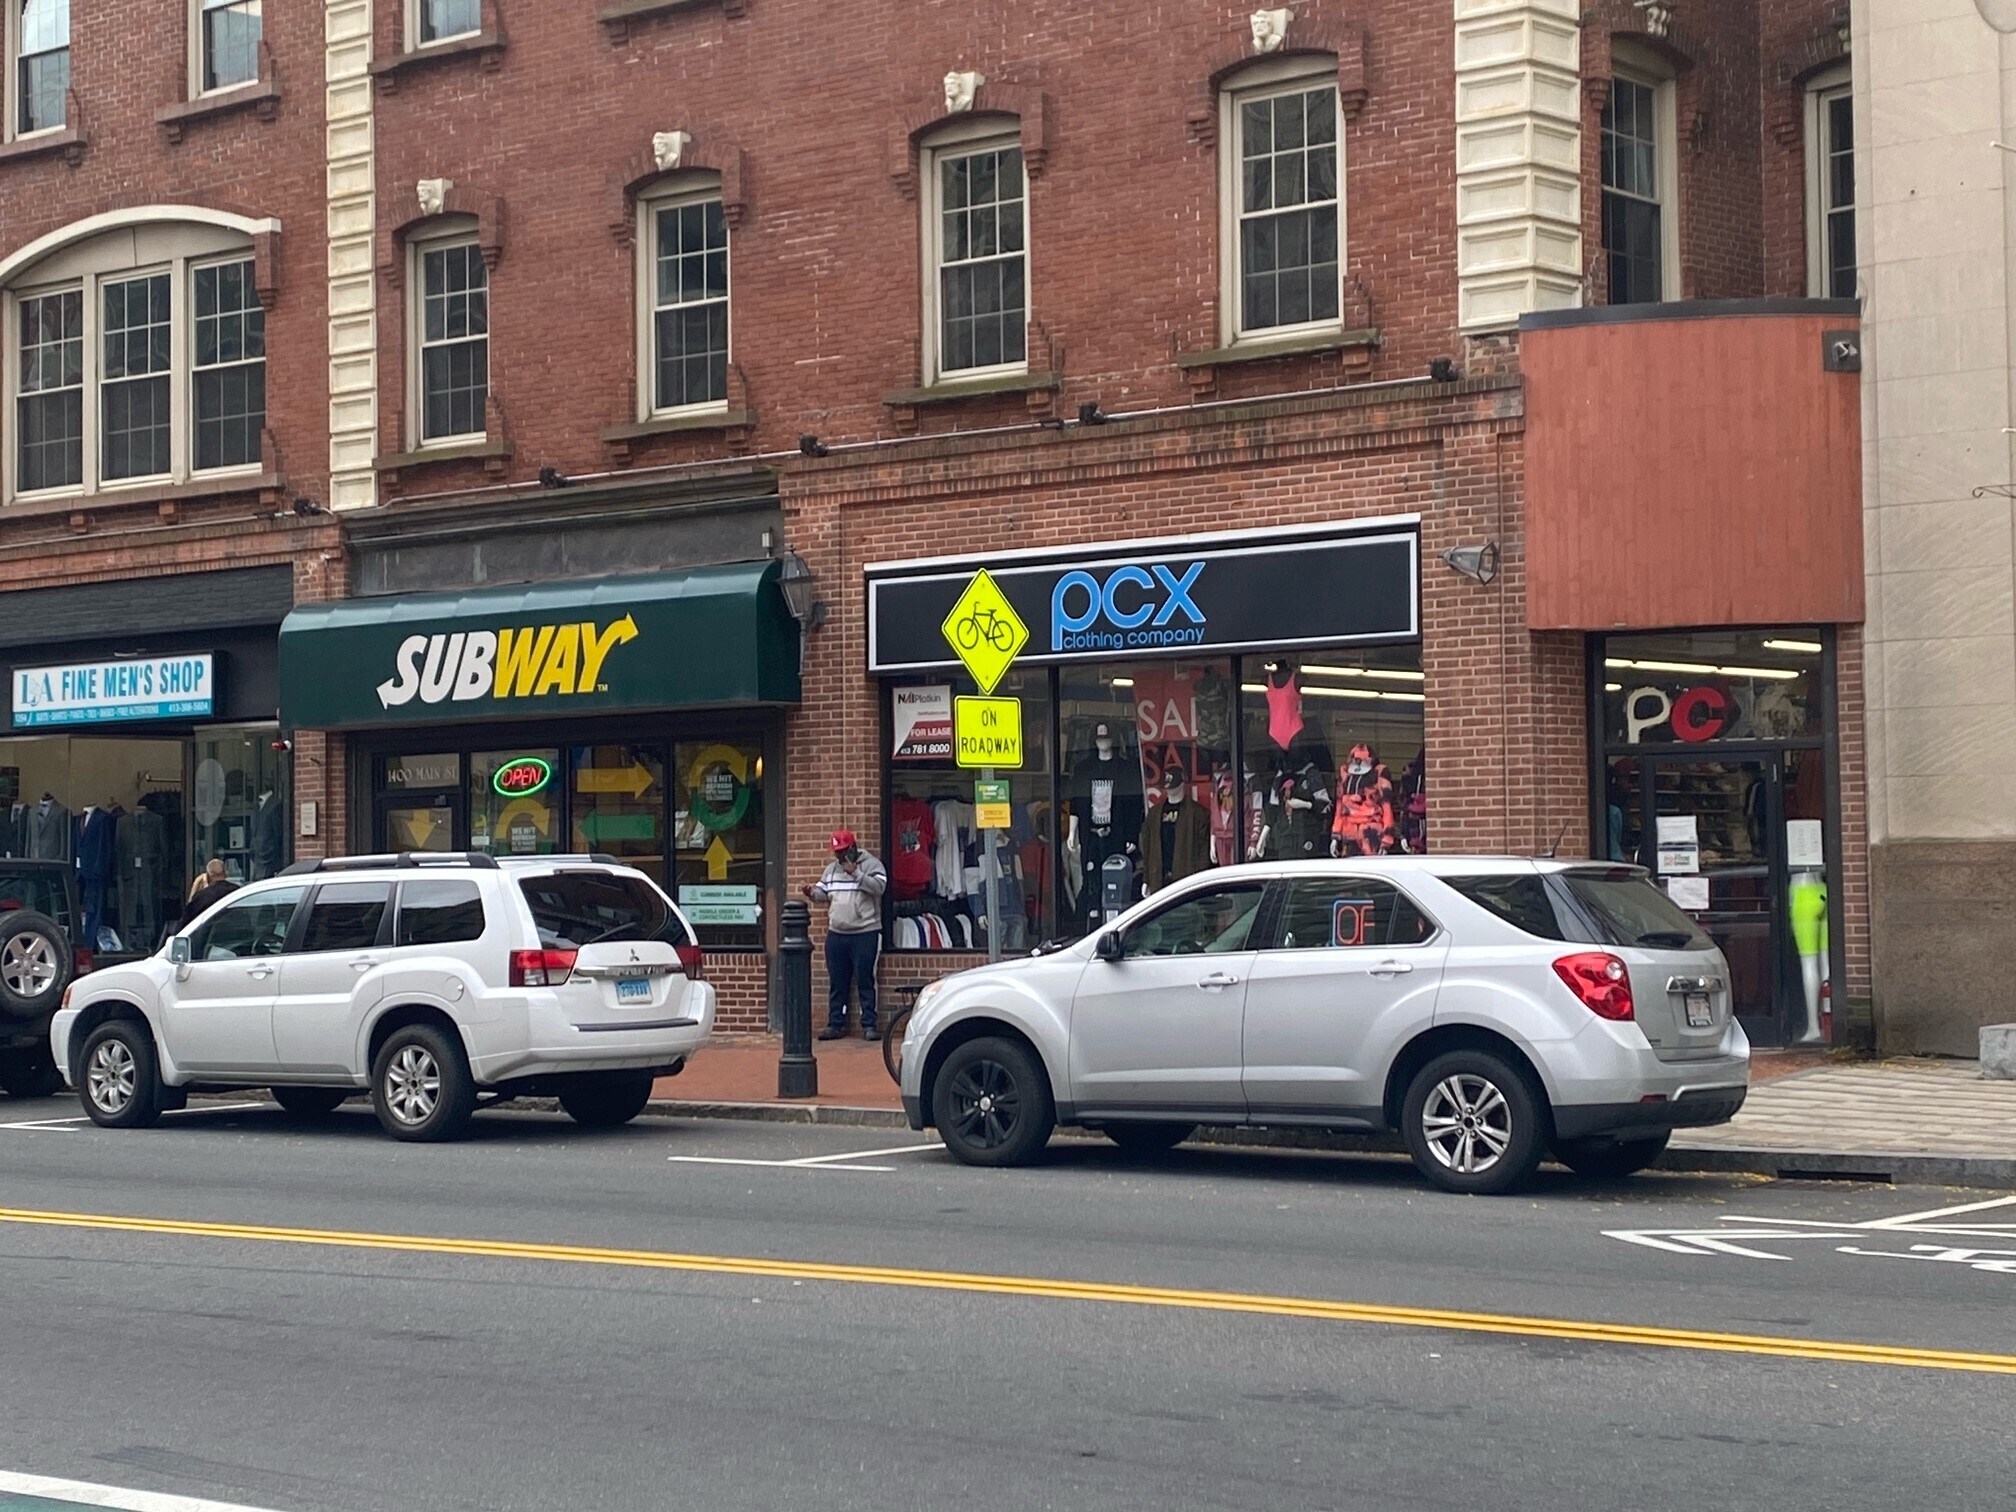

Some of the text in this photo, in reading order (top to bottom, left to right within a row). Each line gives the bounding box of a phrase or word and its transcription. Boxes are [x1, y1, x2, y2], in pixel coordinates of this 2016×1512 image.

[1063, 628, 1205, 649] clothing company
[376, 612, 639, 710] SUBWAY
[62, 668, 97, 701] FINE
[104, 664, 153, 698] MEN'S
[160, 660, 204, 694] SHOP
[981, 711, 997, 726] ON
[1137, 698, 1199, 741] SAL
[911, 727, 951, 737] FOR LEASE
[912, 744, 927, 754] 781
[929, 743, 950, 753] 8000
[961, 737, 1017, 754] ROADWAY
[416, 767, 440, 781] MAIN
[501, 765, 542, 787] OPEN
